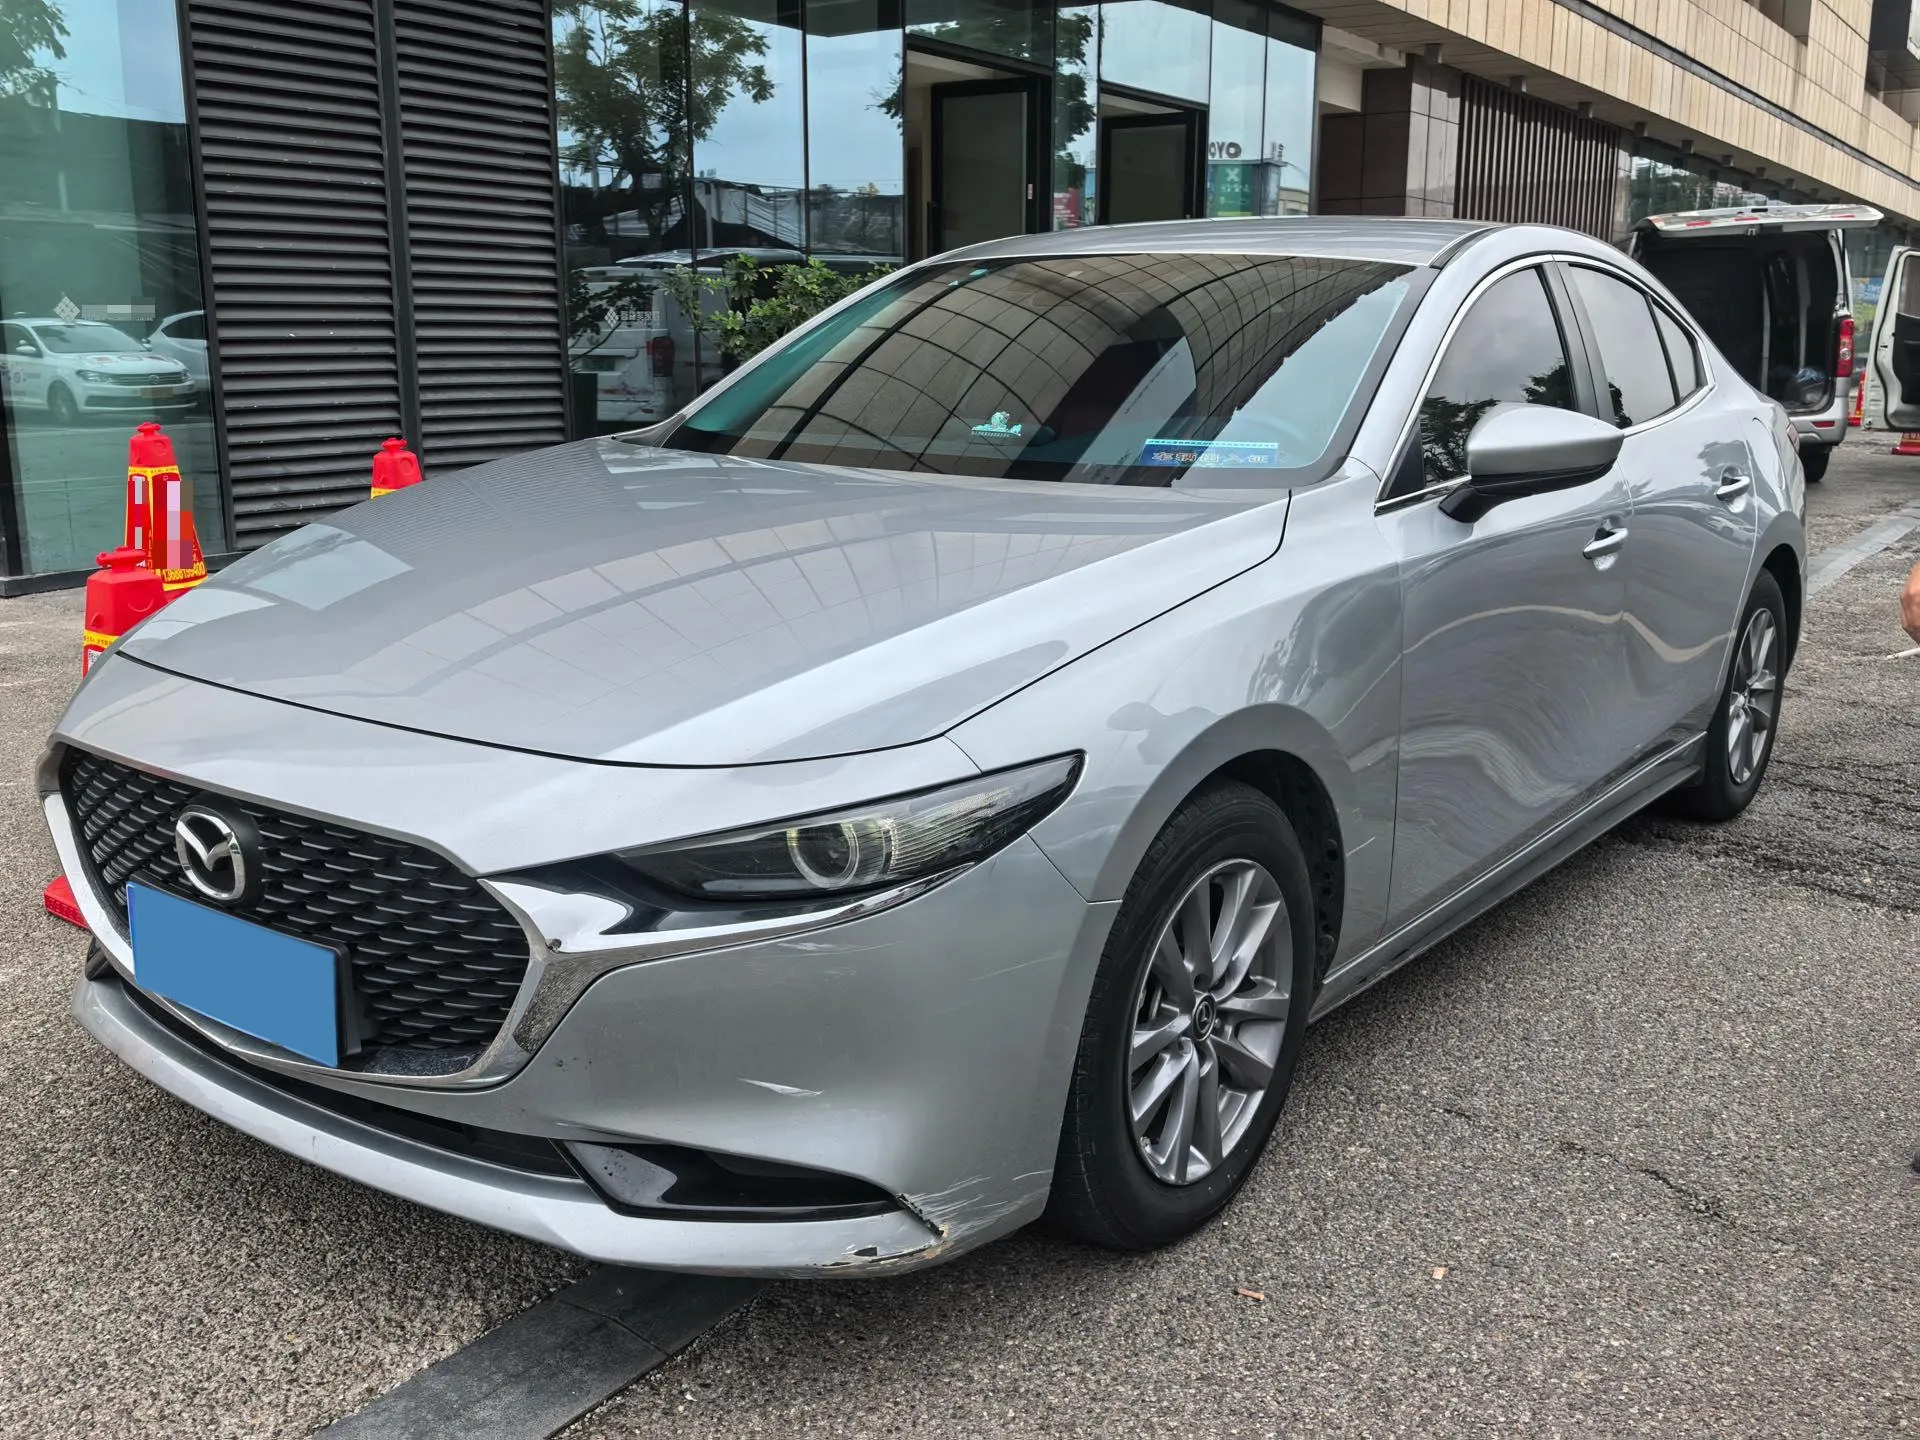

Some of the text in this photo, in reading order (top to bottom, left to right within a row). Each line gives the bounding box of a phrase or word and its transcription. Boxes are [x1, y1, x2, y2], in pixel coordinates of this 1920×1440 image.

[1152, 452, 1269, 463] 车辆出入证
